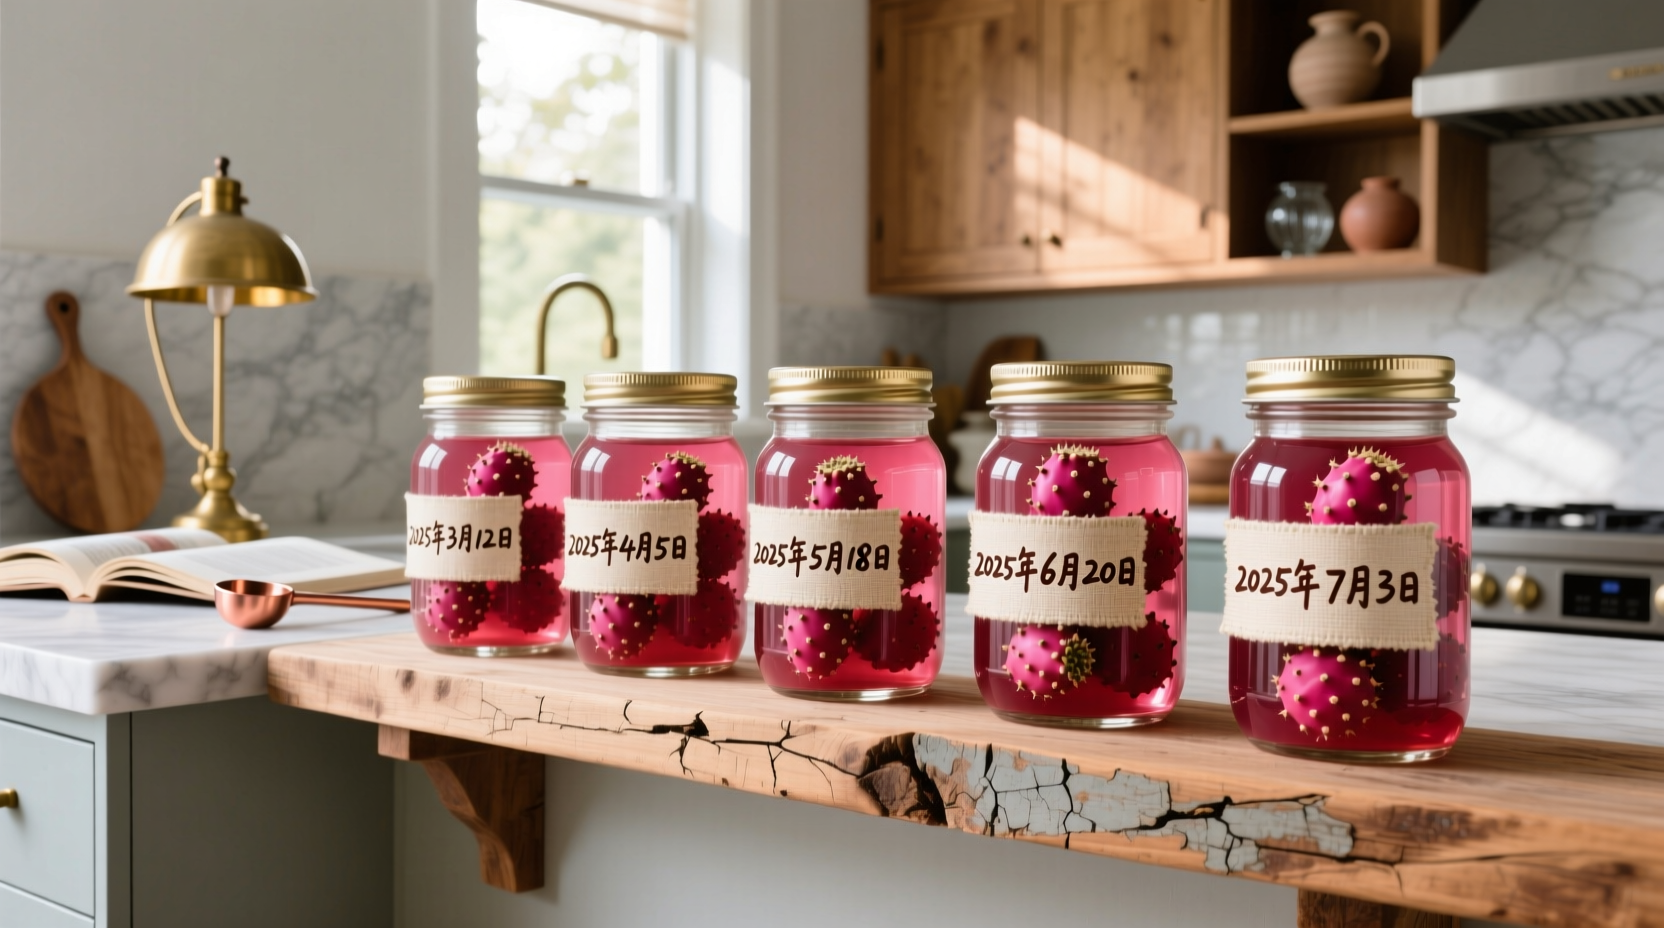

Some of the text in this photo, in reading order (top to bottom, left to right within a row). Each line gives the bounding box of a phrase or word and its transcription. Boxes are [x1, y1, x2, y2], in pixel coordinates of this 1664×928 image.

[408, 520, 512, 555] 2025年3月12日
[568, 528, 687, 566] 2025年4月5日
[753, 536, 890, 577] 2025年5月18日
[974, 546, 1136, 593] 2025年6月20日
[1235, 558, 1419, 611] 2025年7月3日
